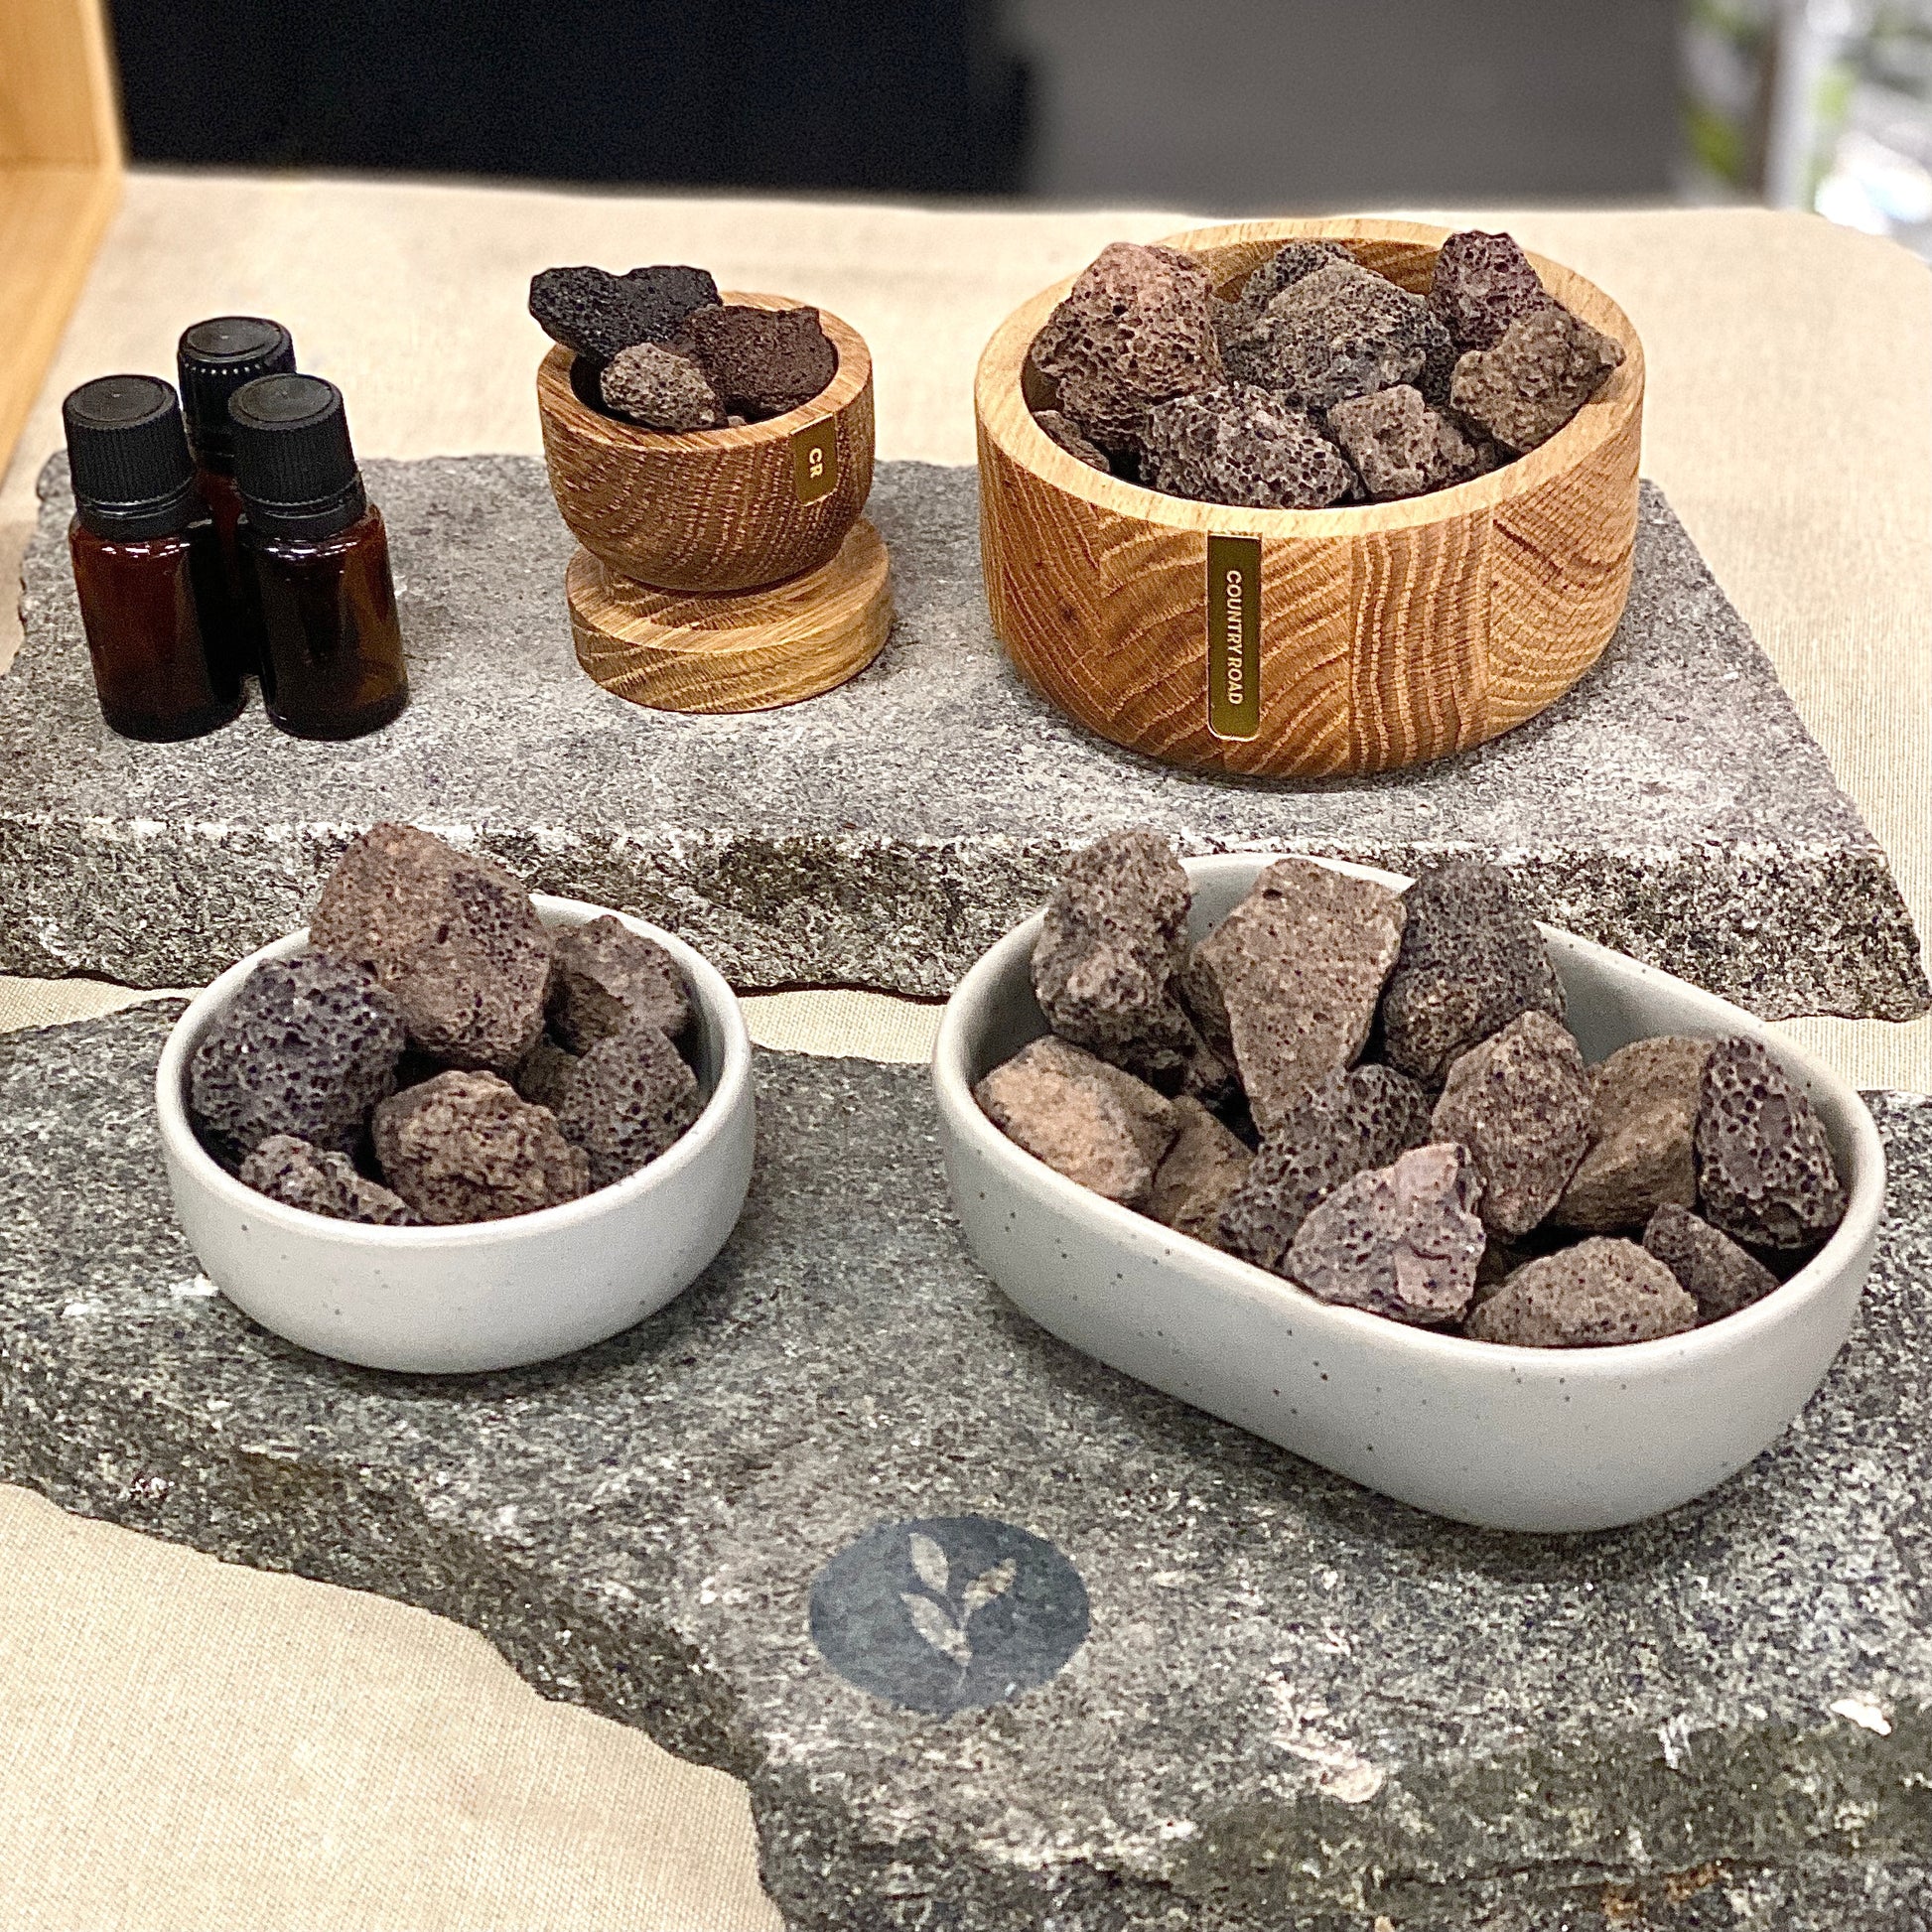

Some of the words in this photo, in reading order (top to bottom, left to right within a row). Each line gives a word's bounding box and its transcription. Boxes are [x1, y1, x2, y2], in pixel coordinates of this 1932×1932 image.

[809, 448, 823, 479] CR
[1226, 570, 1243, 655] COUNTRY
[1227, 656, 1244, 705] ROAD
